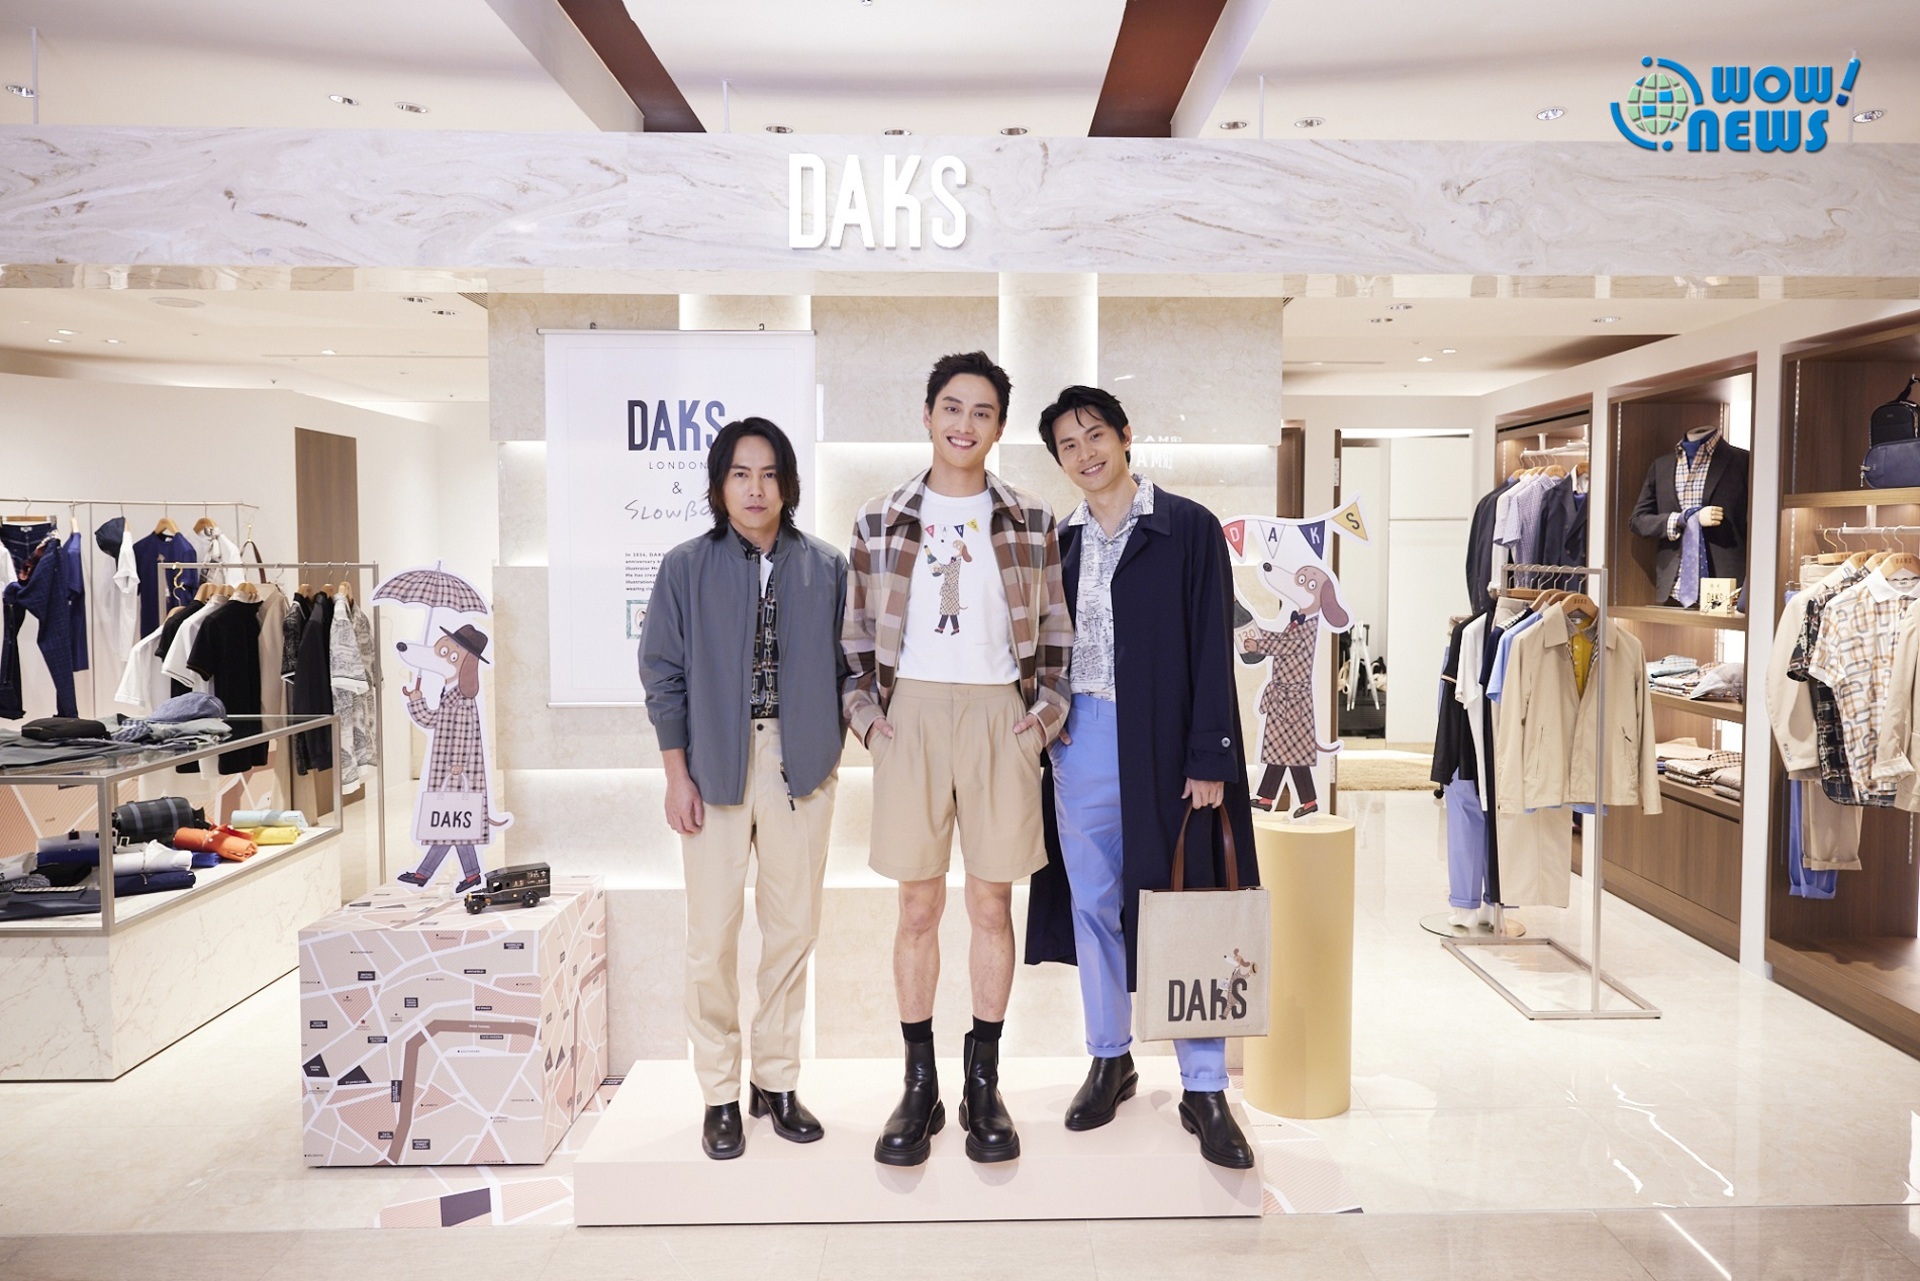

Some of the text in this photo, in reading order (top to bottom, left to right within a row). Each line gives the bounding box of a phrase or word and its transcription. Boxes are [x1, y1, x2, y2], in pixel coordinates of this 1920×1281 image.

[789, 153, 967, 250] DAKS
[627, 400, 726, 451] DAKS
[648, 461, 707, 470] LONDON
[672, 481, 682, 494] &
[430, 810, 473, 829] DAKS
